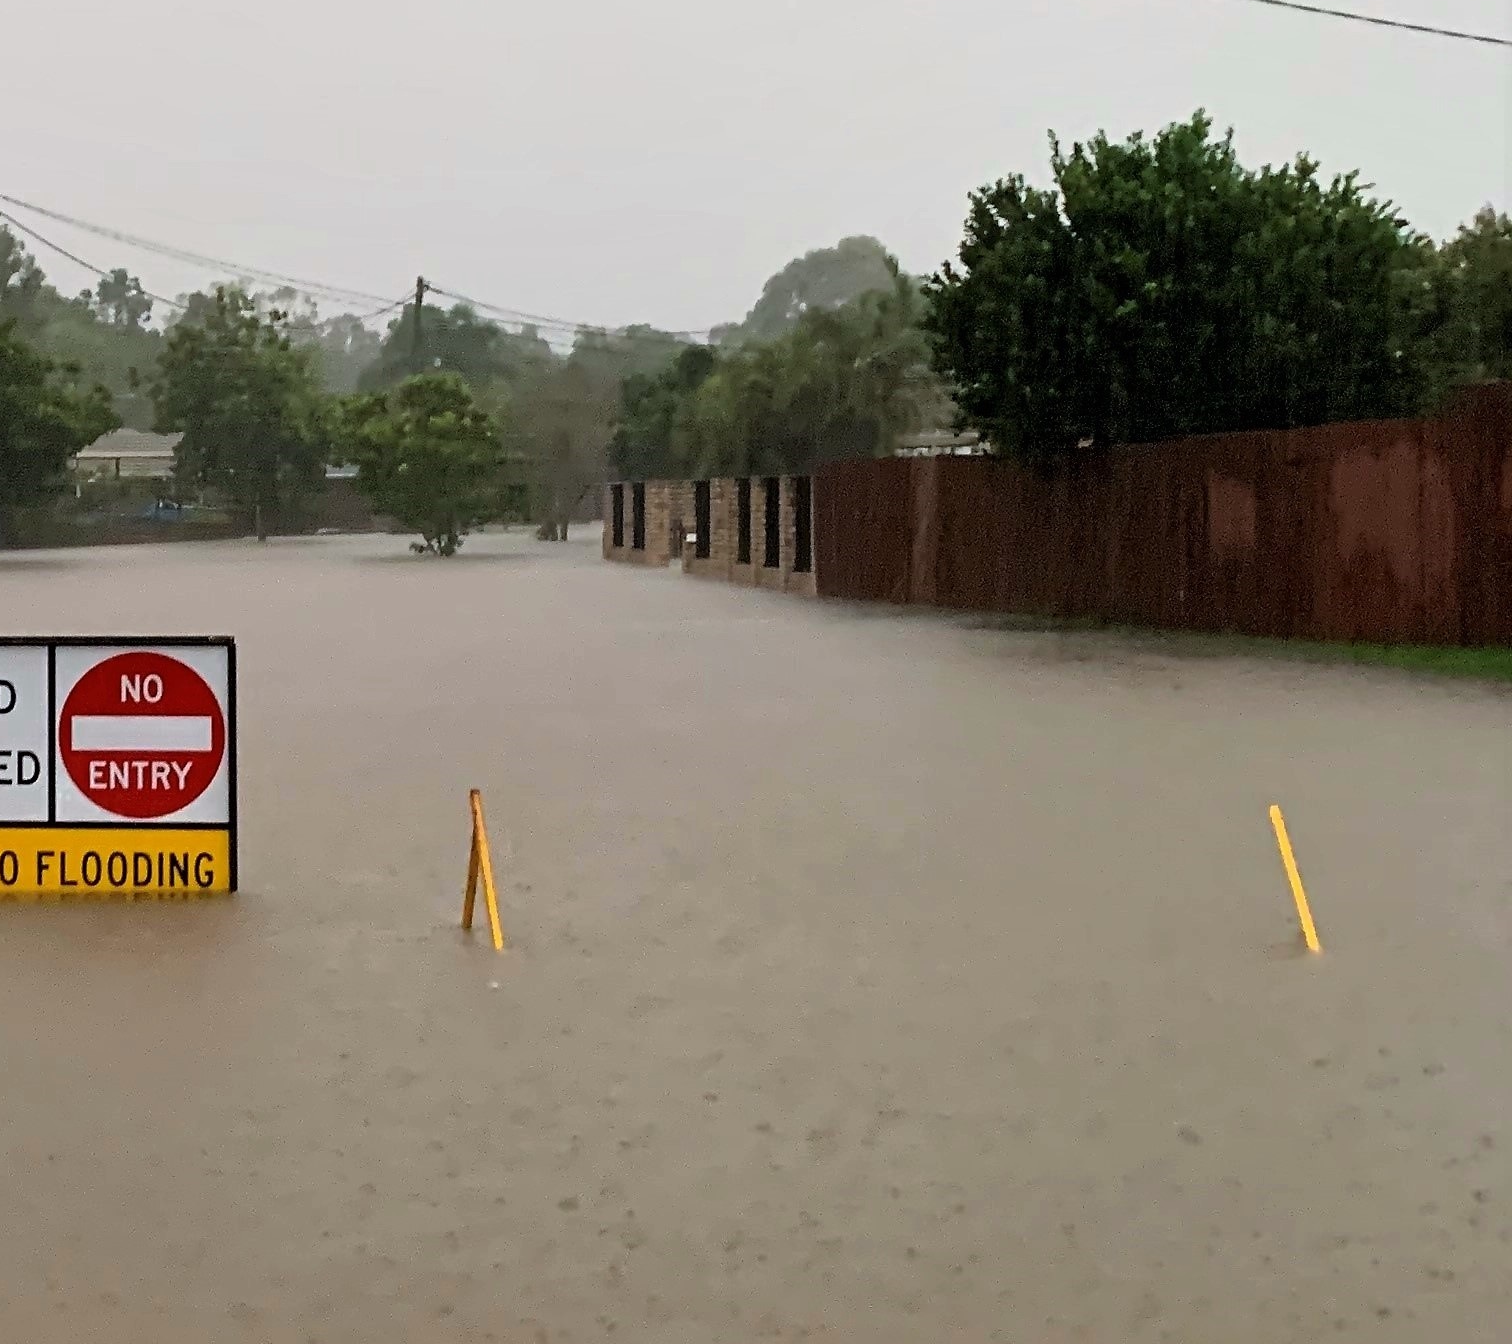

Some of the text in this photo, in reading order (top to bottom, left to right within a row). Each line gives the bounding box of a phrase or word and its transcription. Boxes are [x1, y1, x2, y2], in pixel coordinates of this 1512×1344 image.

[120, 674, 164, 703] NO
[89, 761, 193, 790] ENTRY
[36, 850, 214, 887] FLOODING
